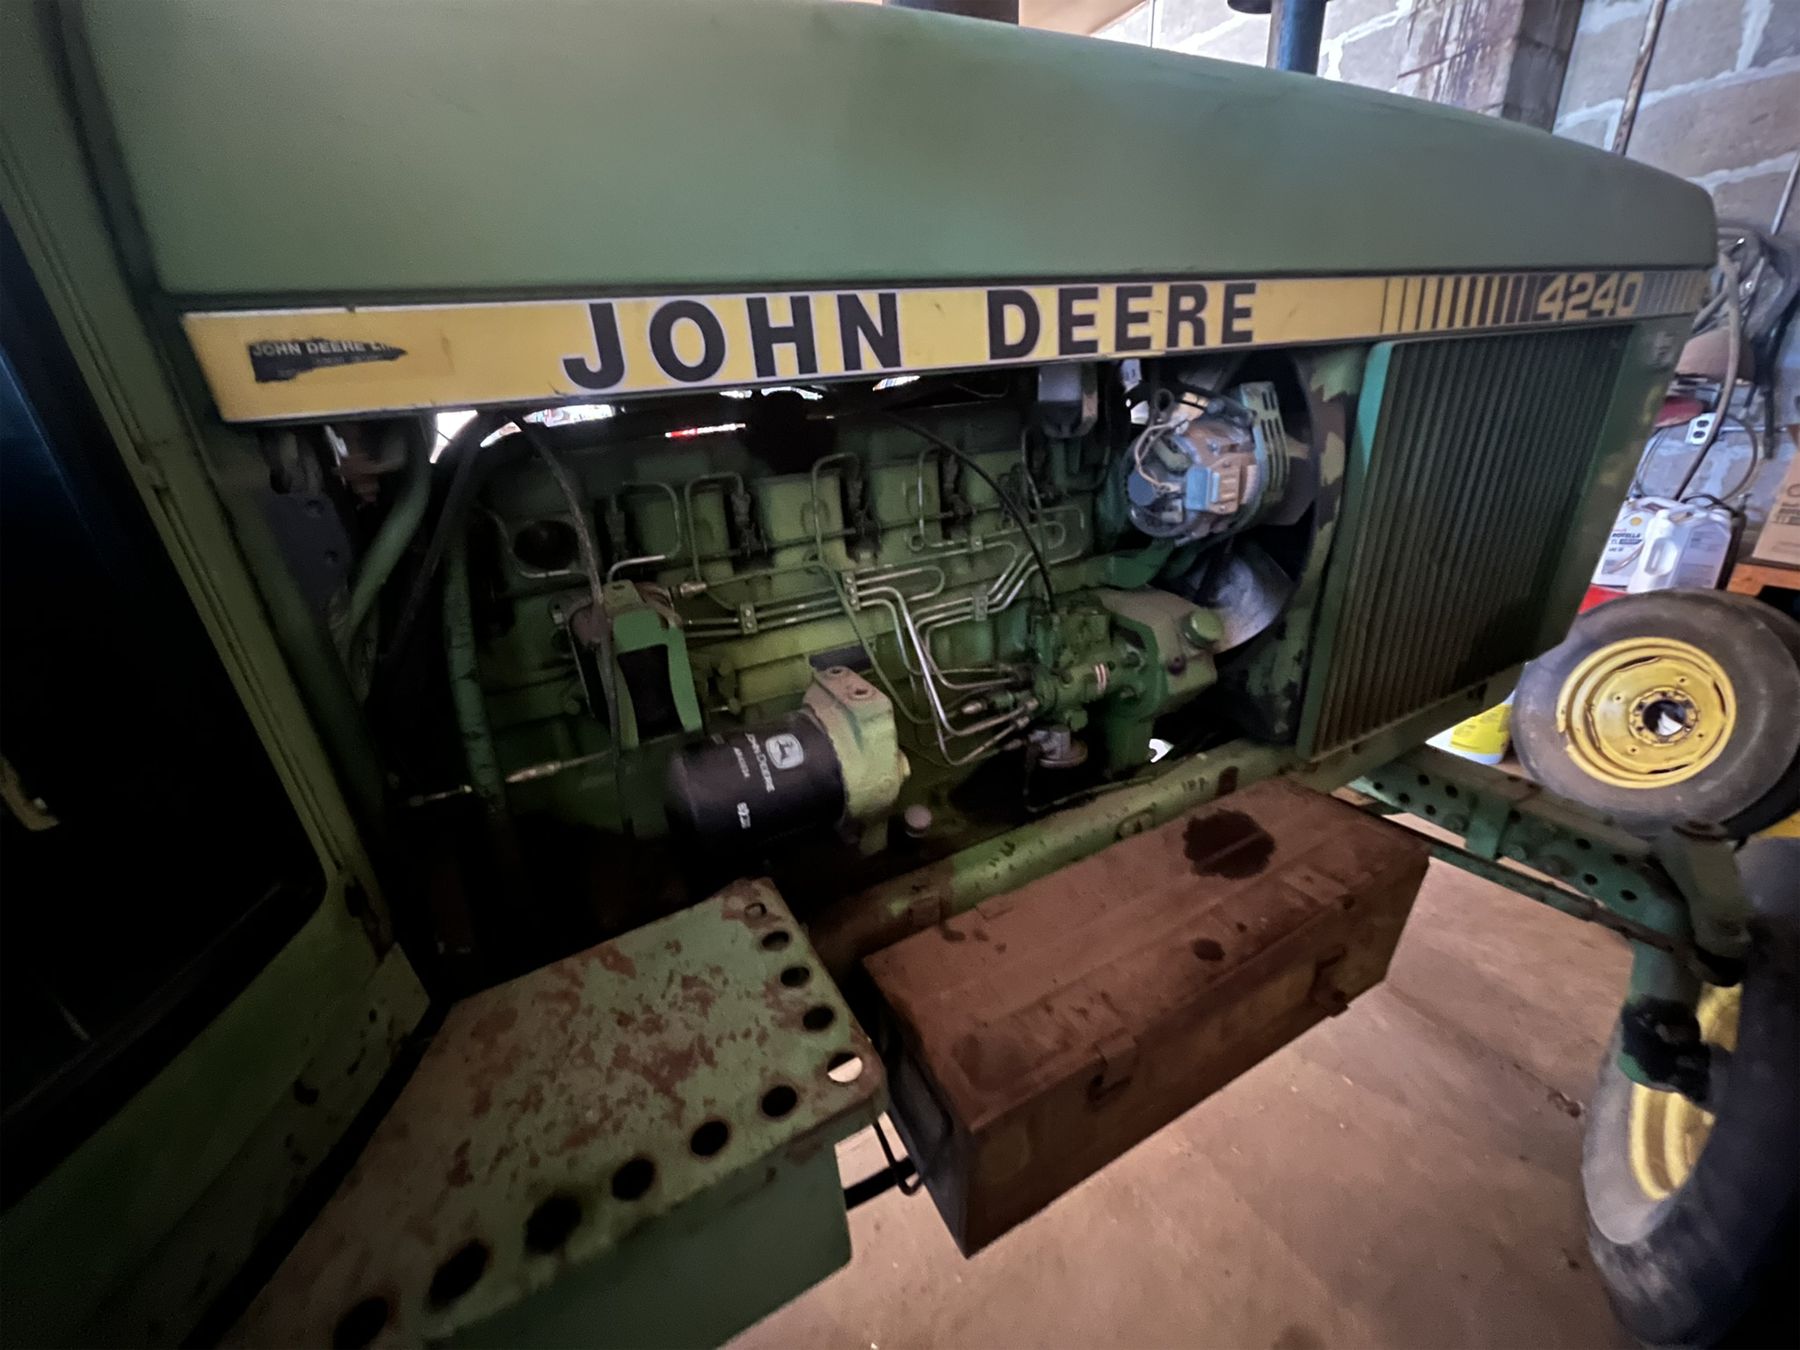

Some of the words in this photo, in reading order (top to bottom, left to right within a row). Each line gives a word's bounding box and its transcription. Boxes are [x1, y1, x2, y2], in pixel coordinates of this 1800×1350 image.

[1536, 272, 1644, 321] 4240
[252, 342, 302, 356] JOHN
[306, 341, 364, 354] DEERE
[562, 292, 902, 390] JOHN
[987, 283, 1256, 360] DEERE
